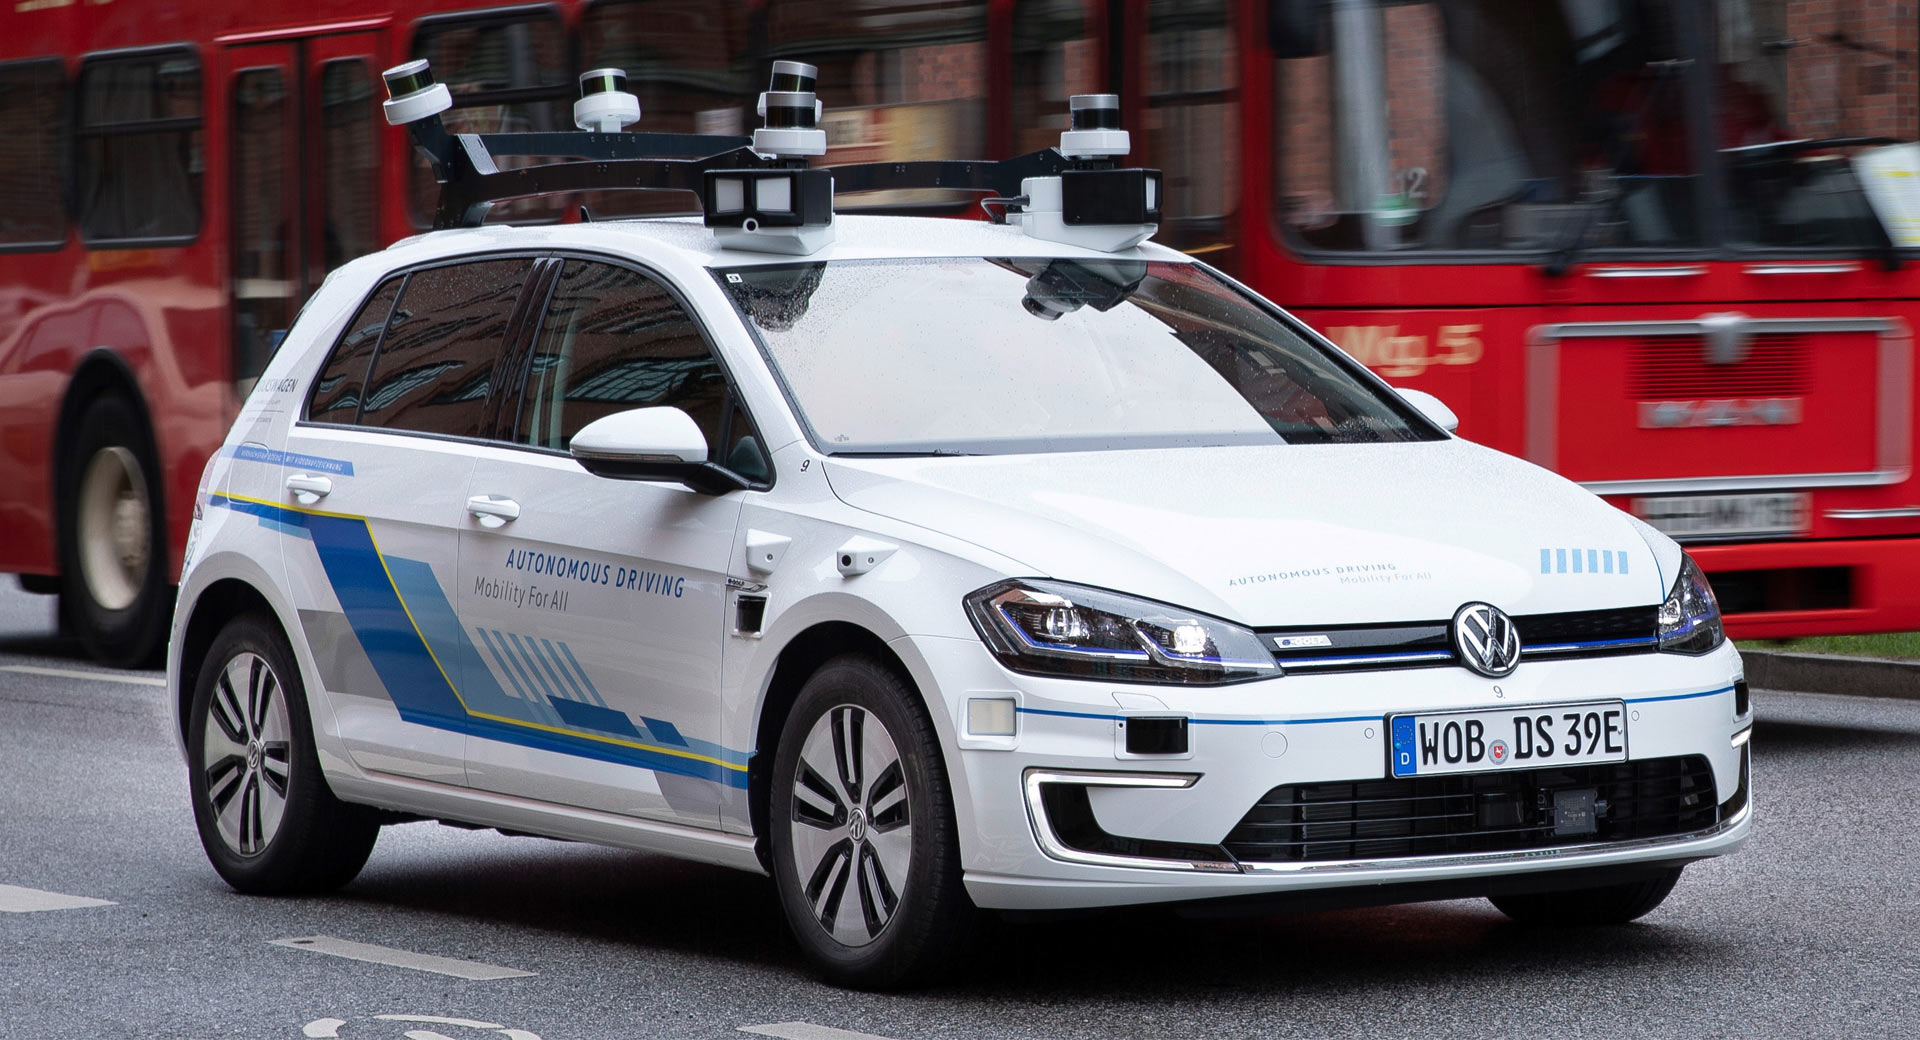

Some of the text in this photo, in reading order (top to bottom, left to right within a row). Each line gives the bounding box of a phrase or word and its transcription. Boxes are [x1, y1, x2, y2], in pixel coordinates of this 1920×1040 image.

[506, 548, 685, 599] AUTONOMOUS DRIVING
[1229, 562, 1397, 587] AUTONOMOUS DRIVING
[1340, 573, 1391, 586] Mobility
[1394, 572, 1413, 582] For
[474, 575, 569, 612] Mobility For All
[1419, 710, 1623, 766] WOB DS 39E
[1400, 752, 1411, 766] D
